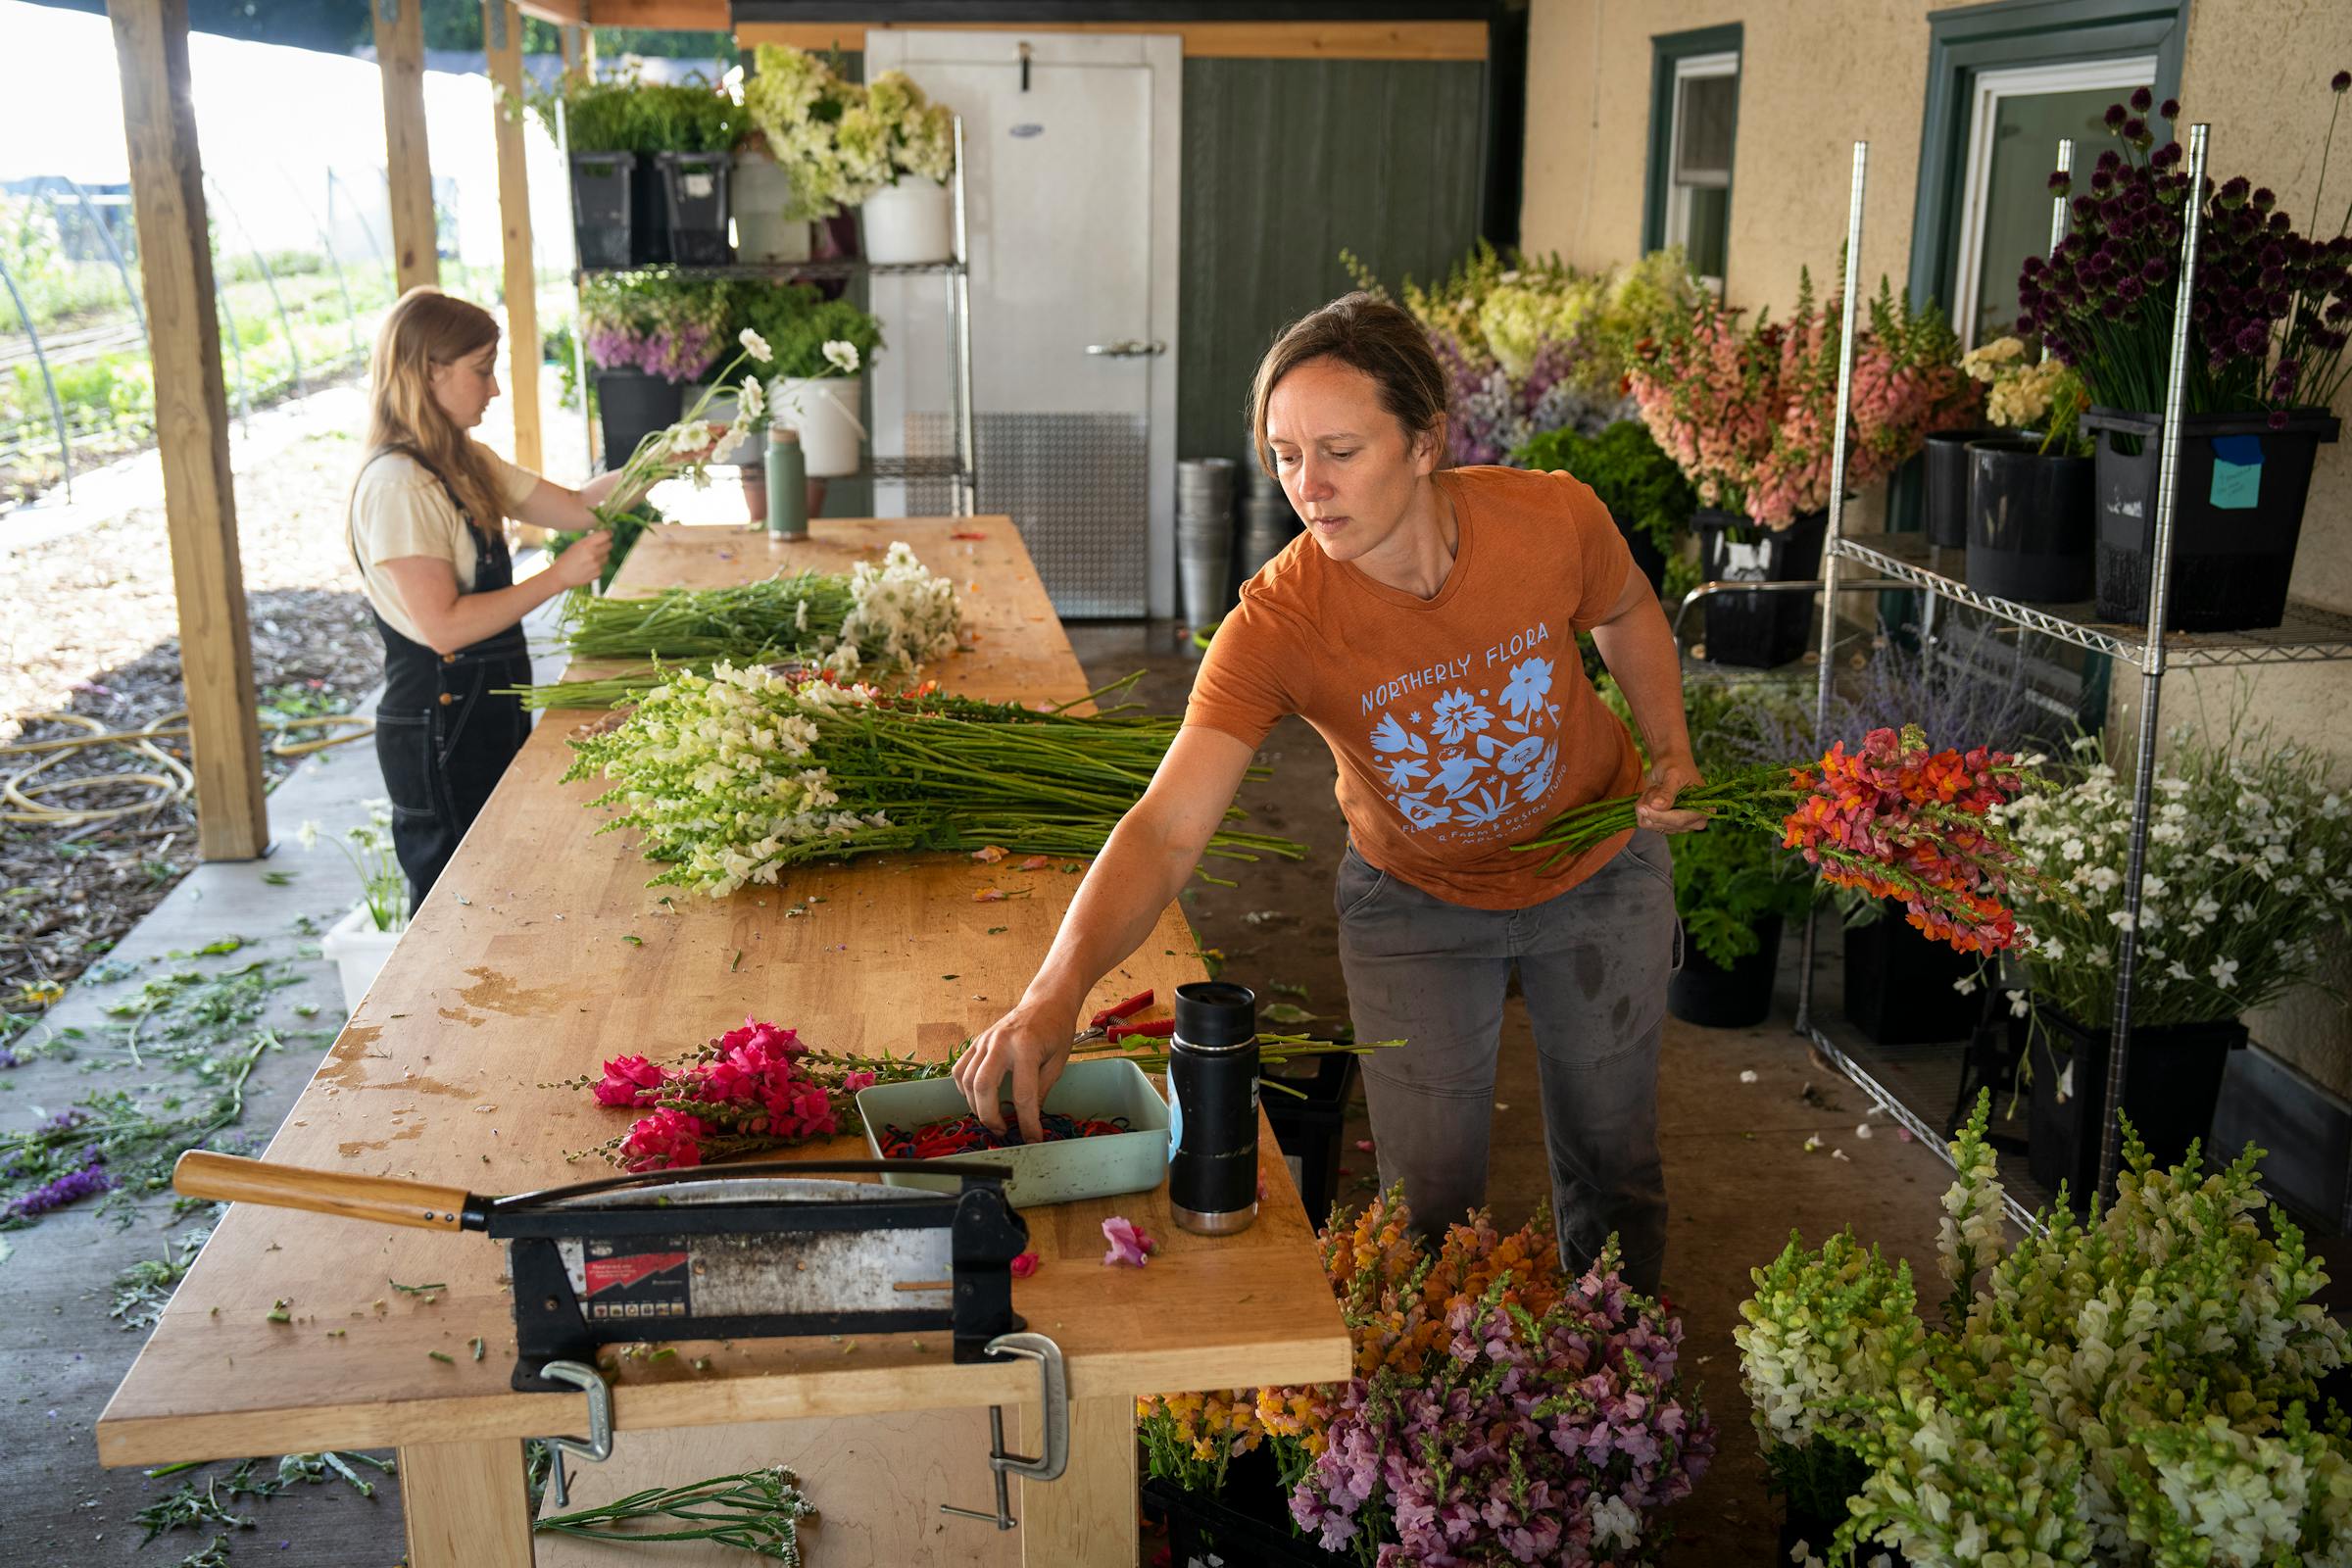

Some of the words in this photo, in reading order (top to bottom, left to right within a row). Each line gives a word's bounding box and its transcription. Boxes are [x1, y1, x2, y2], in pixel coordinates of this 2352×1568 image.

[1361, 654, 1471, 716] NORTHERLY
[1486, 622, 1549, 668] FLORA
[1505, 803, 1546, 825] DESIGN
[1545, 764, 1568, 801] STUDIO
